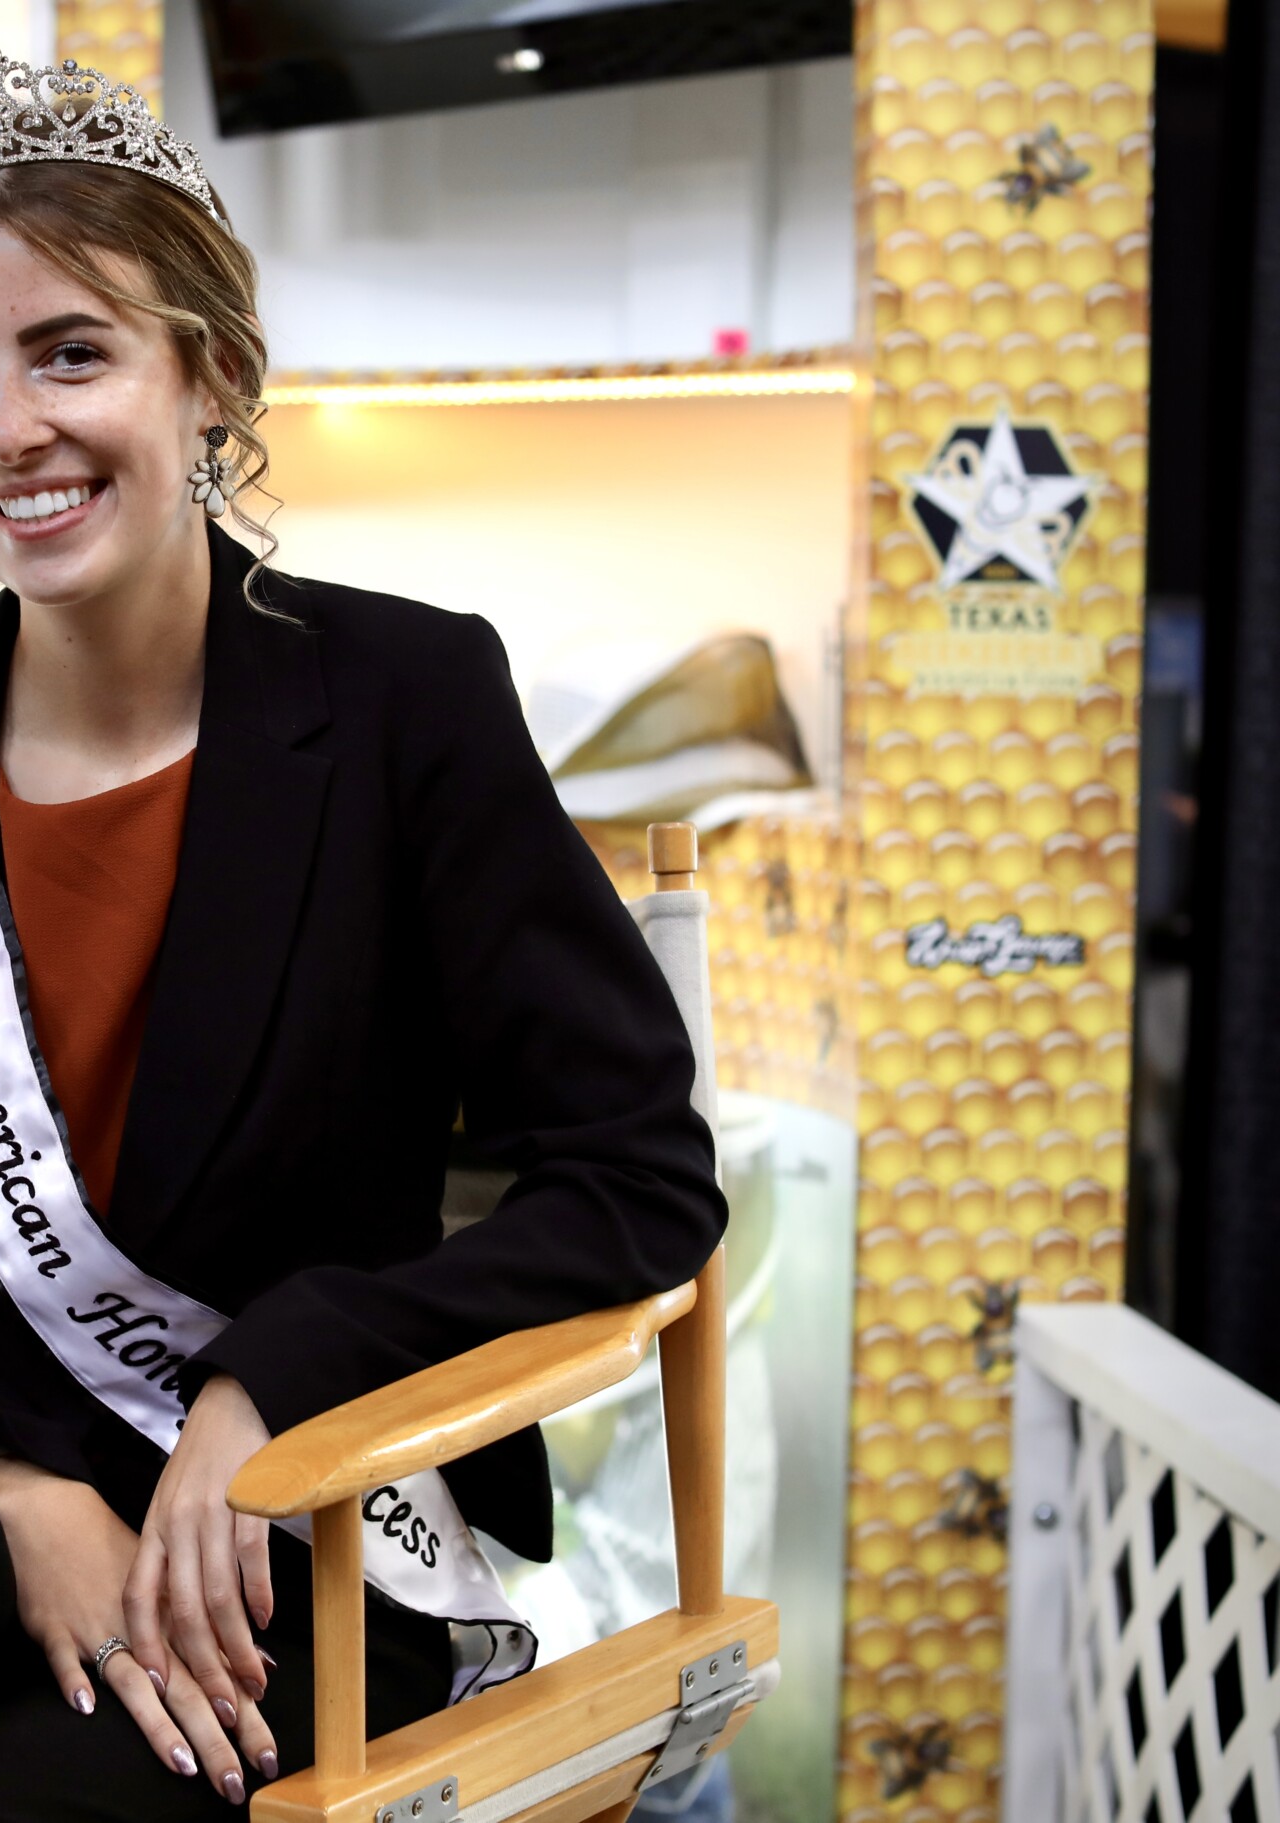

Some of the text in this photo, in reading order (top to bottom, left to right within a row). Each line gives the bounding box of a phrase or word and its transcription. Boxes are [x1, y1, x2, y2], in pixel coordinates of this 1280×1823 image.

[948, 603, 1051, 632] TEXAS
[67, 1293, 186, 1430] Hon
[361, 1485, 441, 1568] cess
